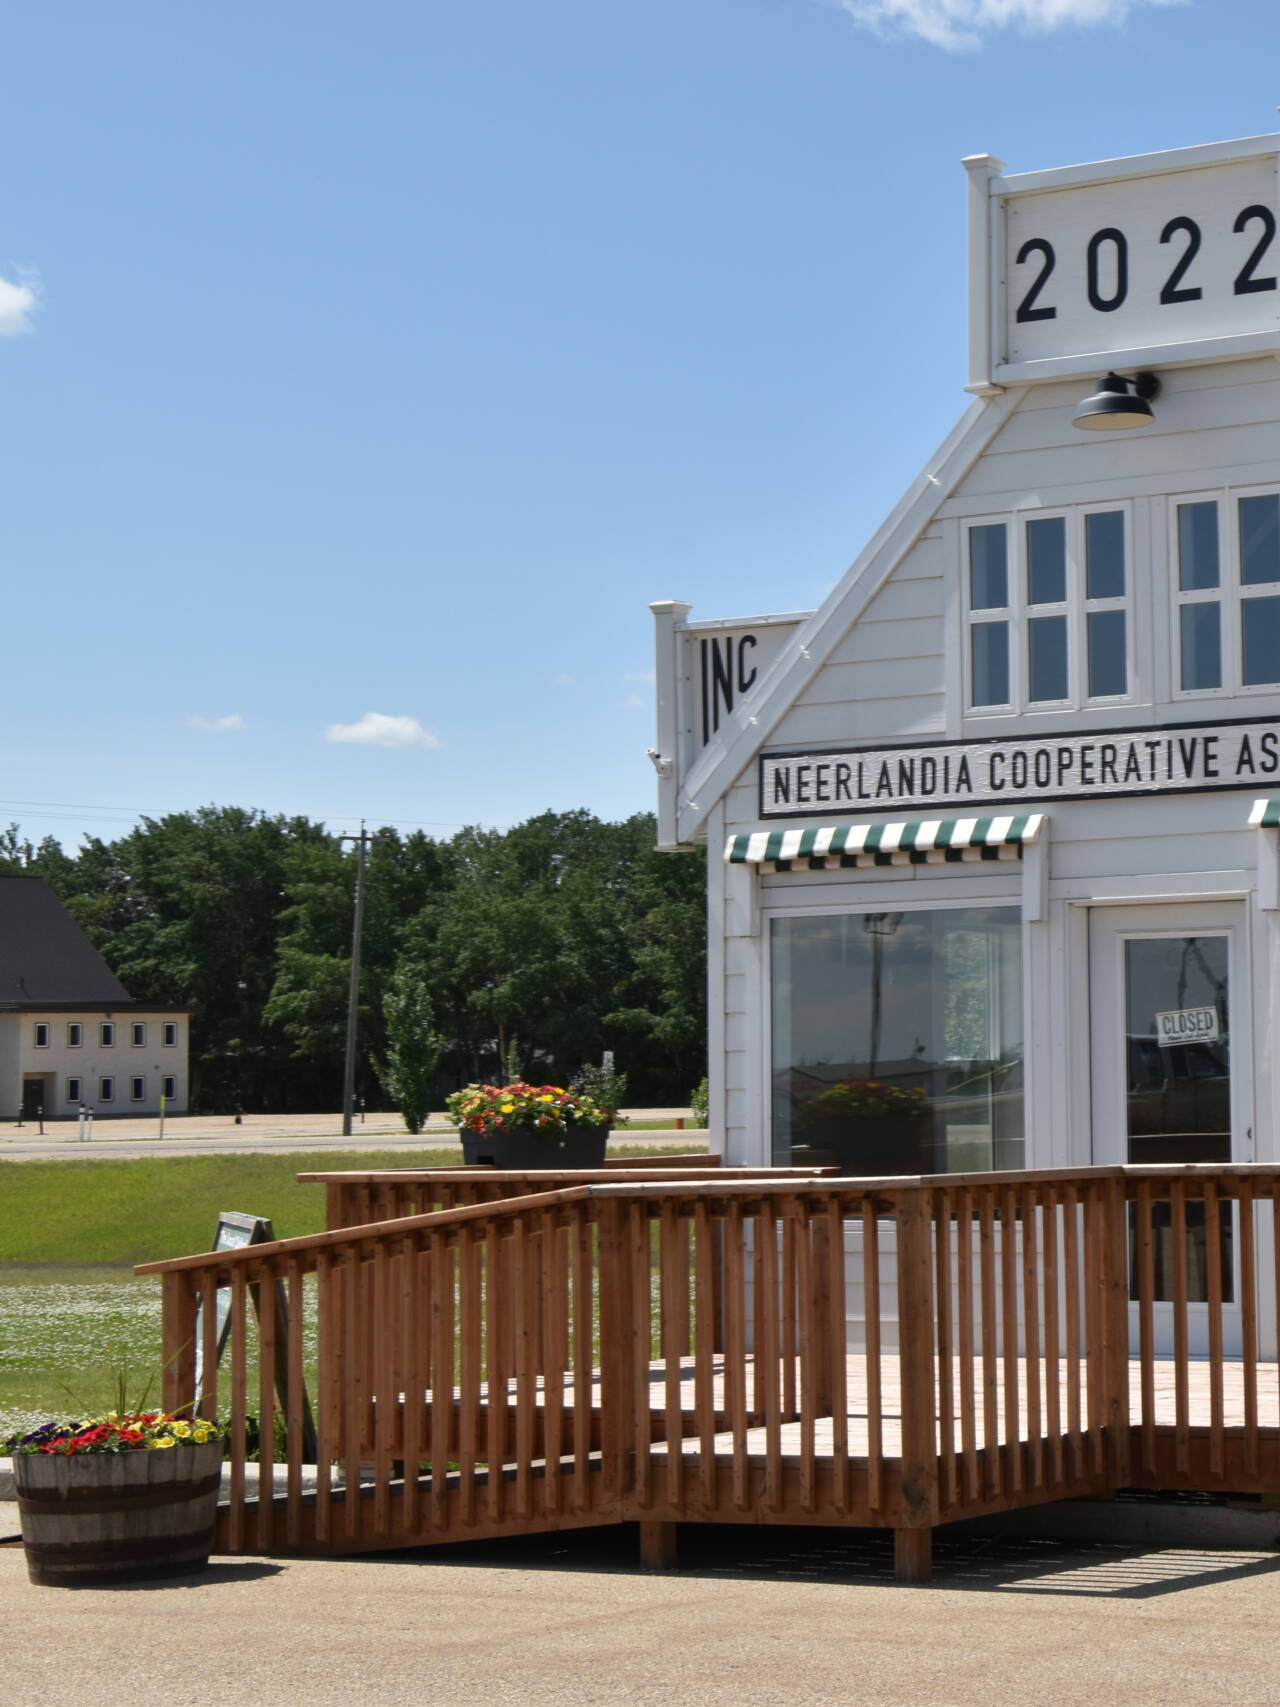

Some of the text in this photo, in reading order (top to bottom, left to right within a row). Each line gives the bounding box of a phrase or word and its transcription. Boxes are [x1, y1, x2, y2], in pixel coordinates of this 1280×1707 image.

[1015, 204, 1278, 324] 2022
[701, 635, 758, 747] INC
[773, 754, 973, 805] NEERLANDIA
[988, 735, 1220, 791] COOPERATIVE
[1162, 1011, 1214, 1035] CLOSED
